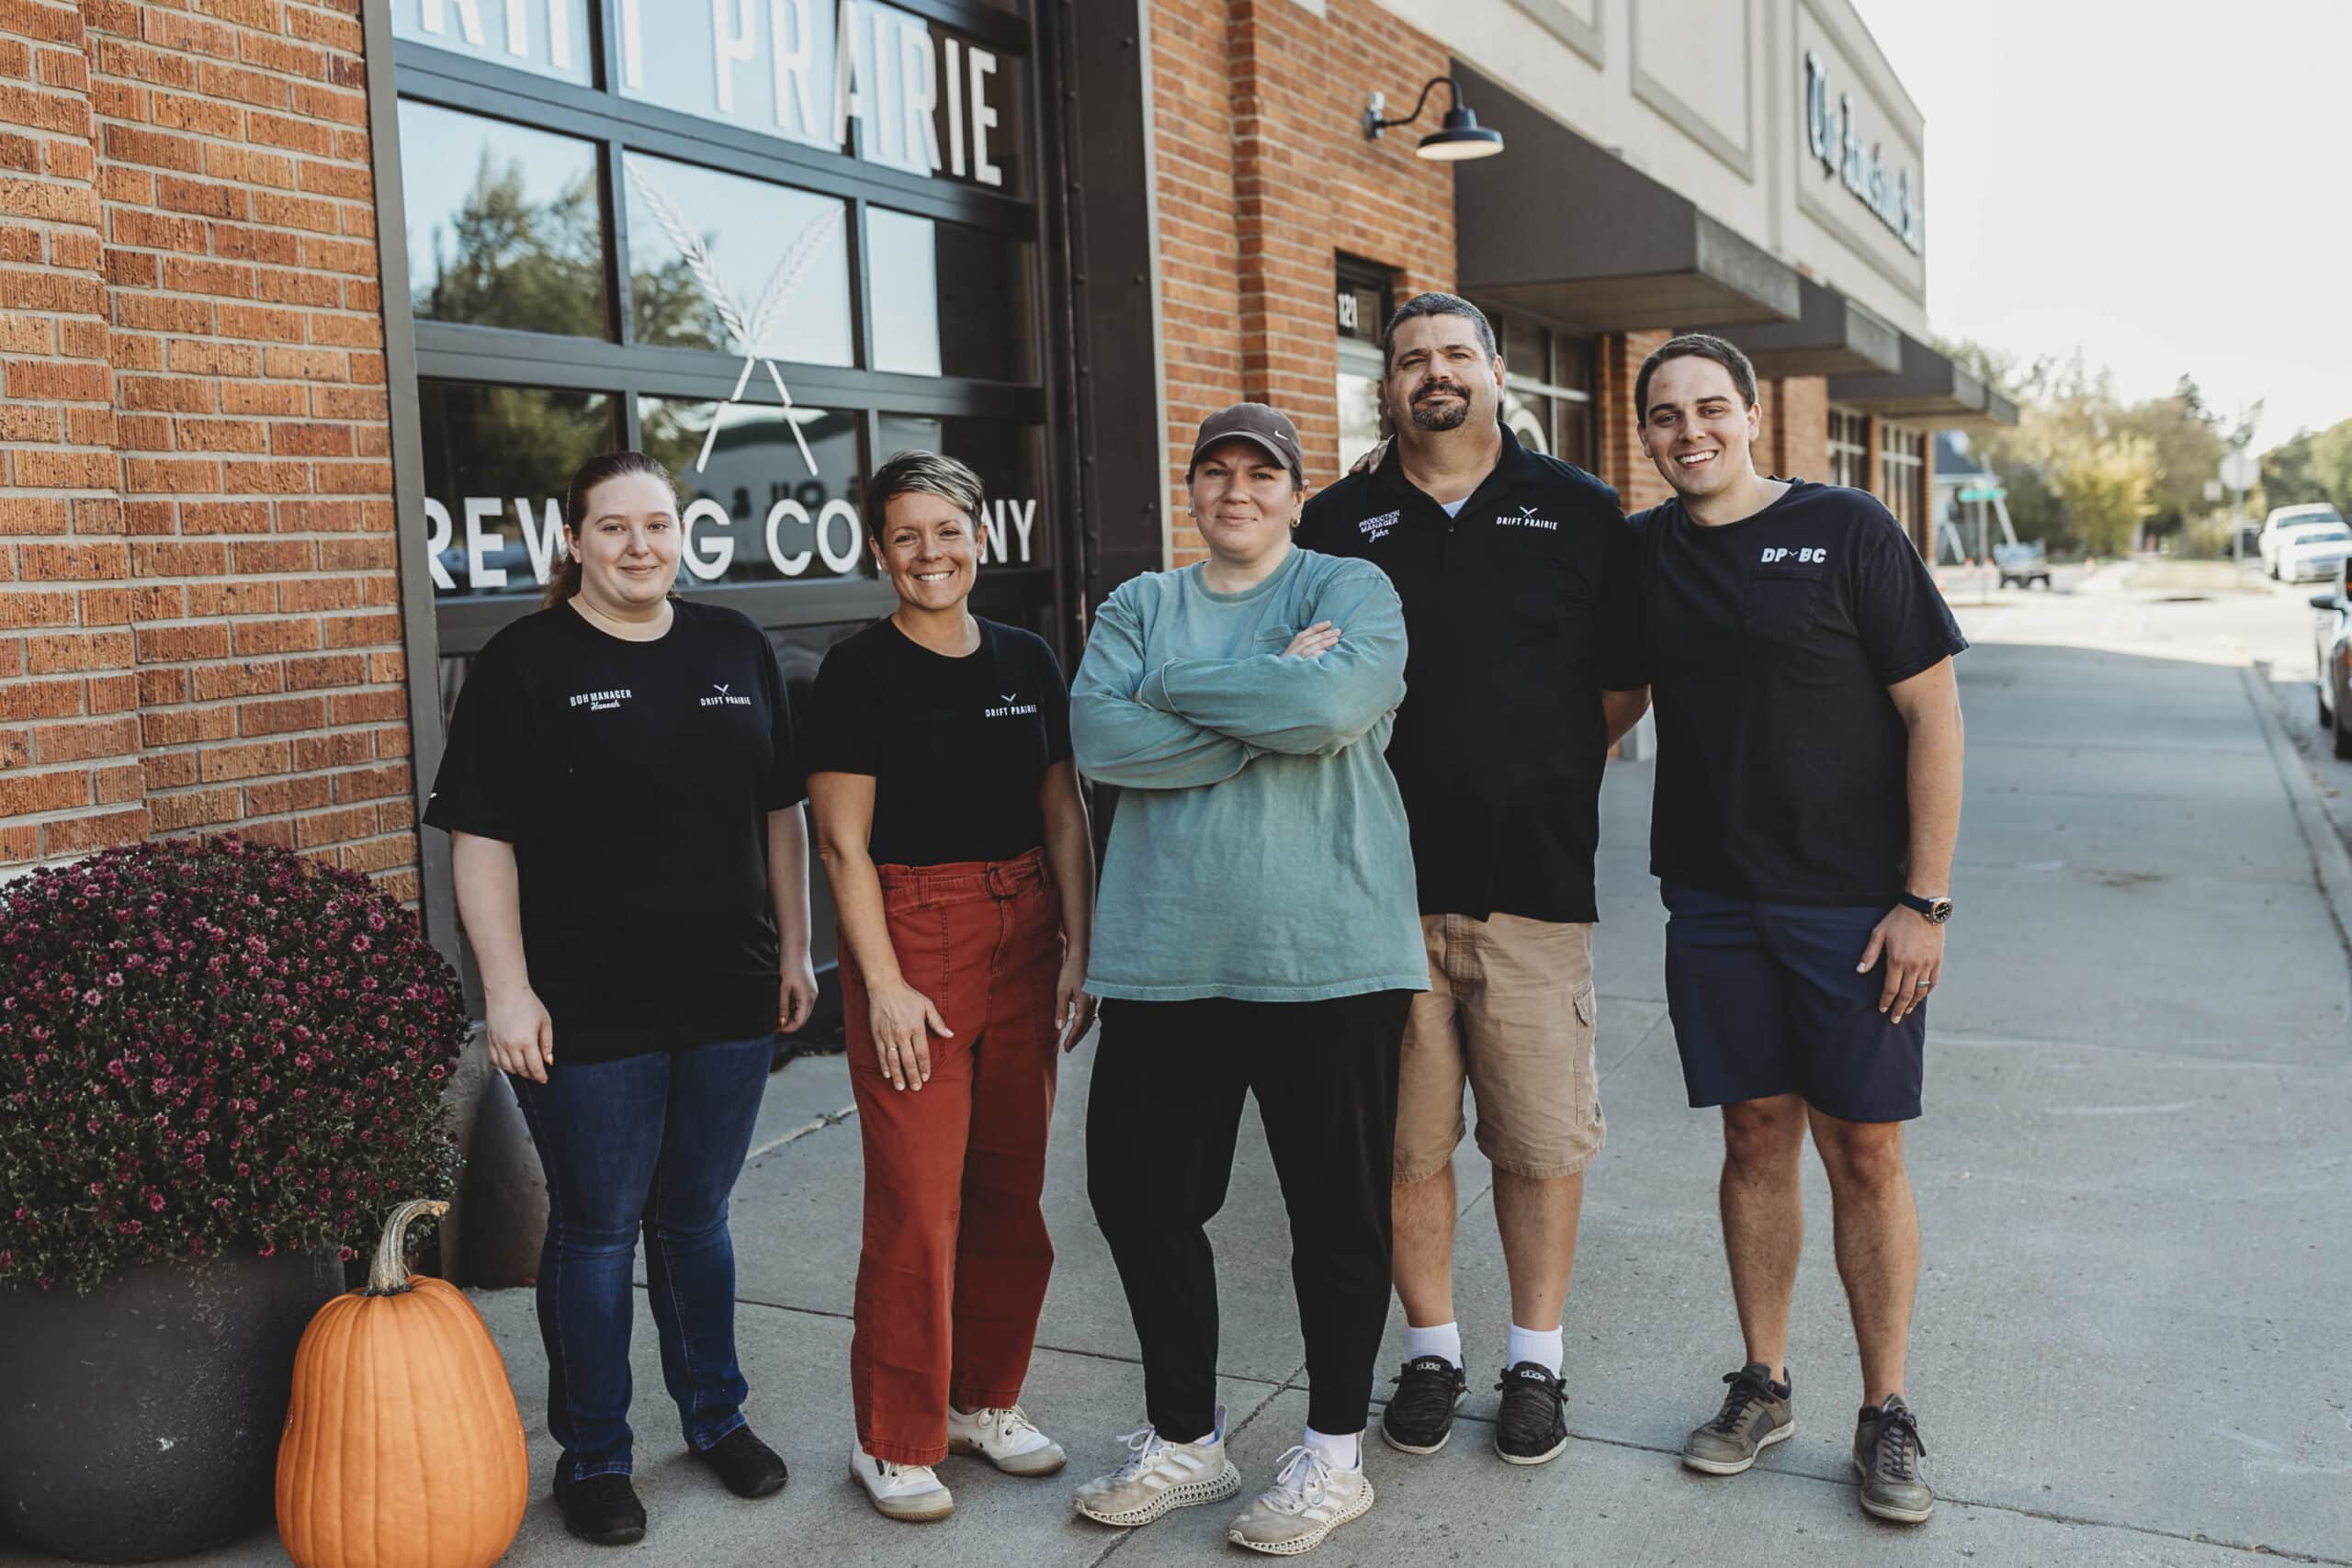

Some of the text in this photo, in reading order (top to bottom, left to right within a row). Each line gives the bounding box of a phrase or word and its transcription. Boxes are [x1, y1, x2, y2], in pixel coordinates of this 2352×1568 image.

[711, 0, 1002, 186] PRAIRIE
[1359, 509, 1400, 528] PRODUCTION
[1361, 517, 1398, 533] MANAGER
[1496, 516, 1558, 530] DRIFT PRAIRIE
[765, 498, 1037, 577] CONY
[570, 689, 632, 706] BOH MANAGER
[591, 699, 621, 711] Hannah
[700, 696, 752, 706] DRIFT PRAIRIE
[985, 705, 1036, 717] DRIFT PRAIRIE
